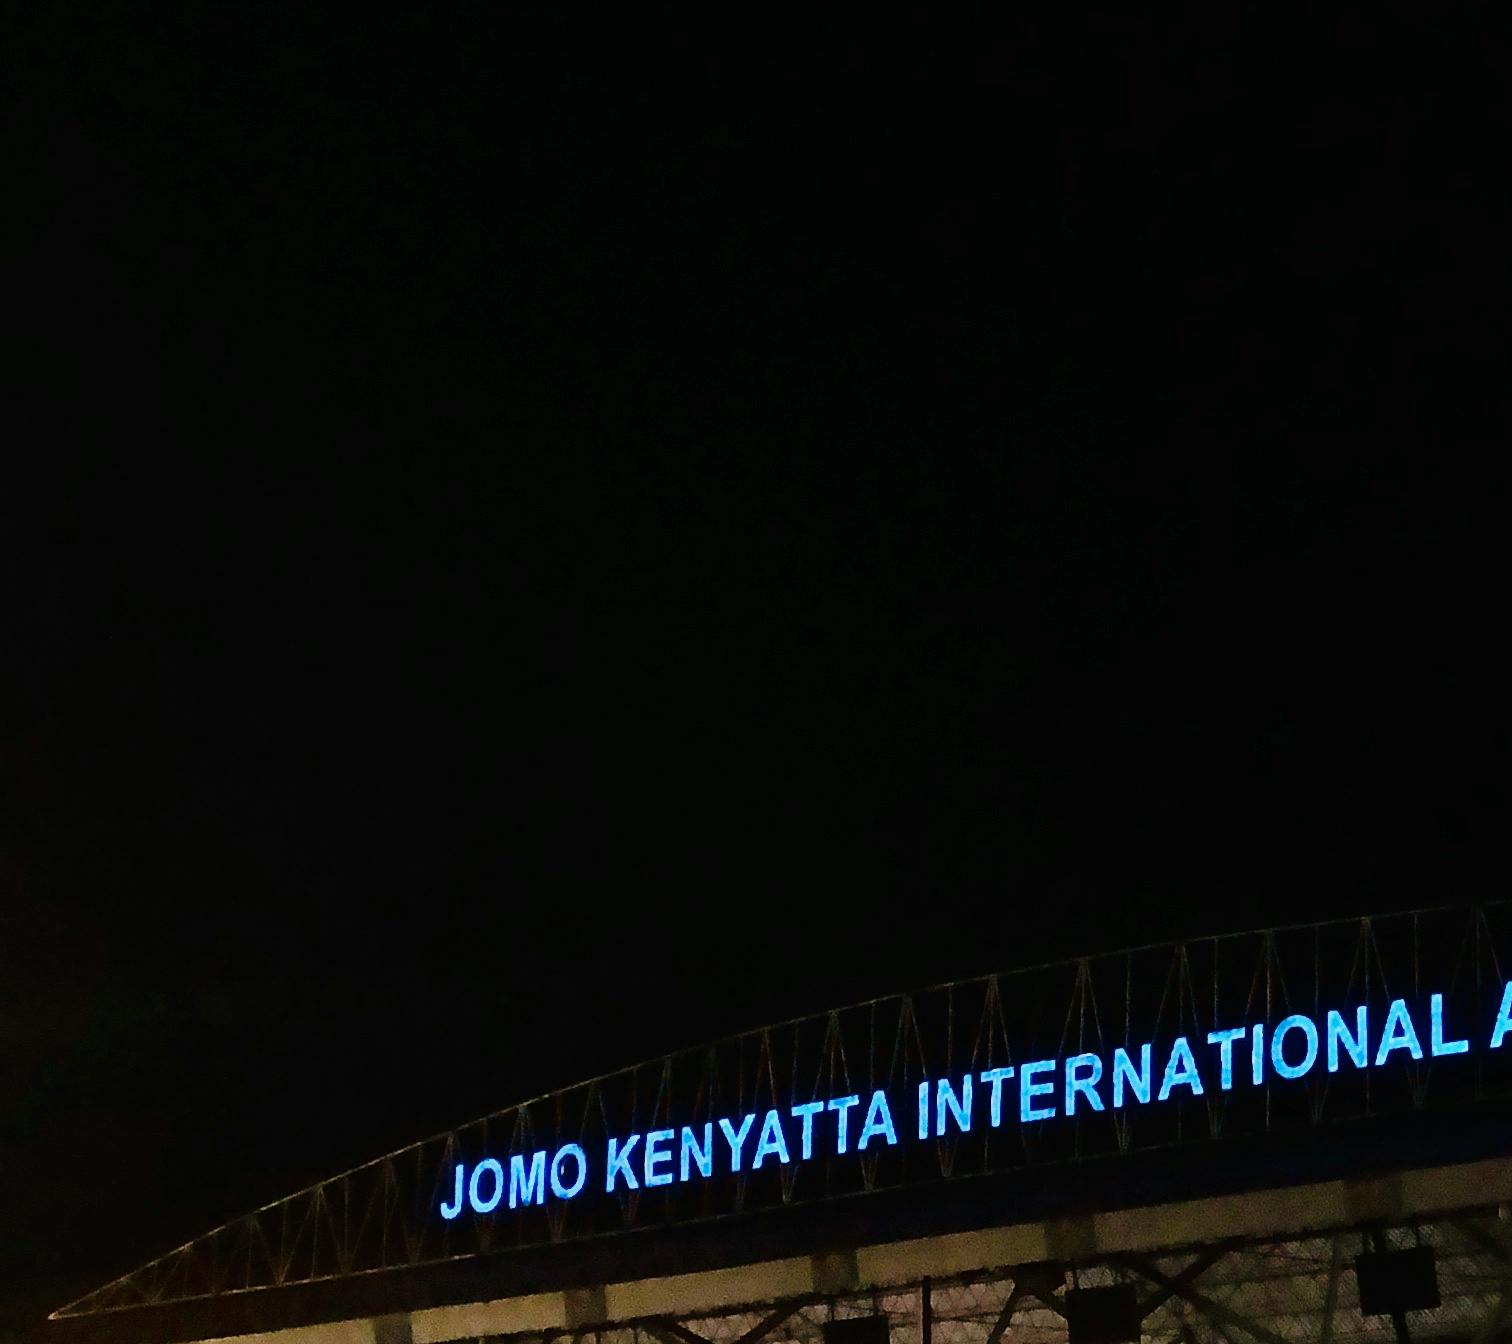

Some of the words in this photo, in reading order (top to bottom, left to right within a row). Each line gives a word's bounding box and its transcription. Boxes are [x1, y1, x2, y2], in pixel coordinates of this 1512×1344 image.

[440, 1143, 588, 1219] JOMO
[606, 1090, 898, 1192] KENYATTA
[917, 992, 1469, 1140] INTERNATIONAL
